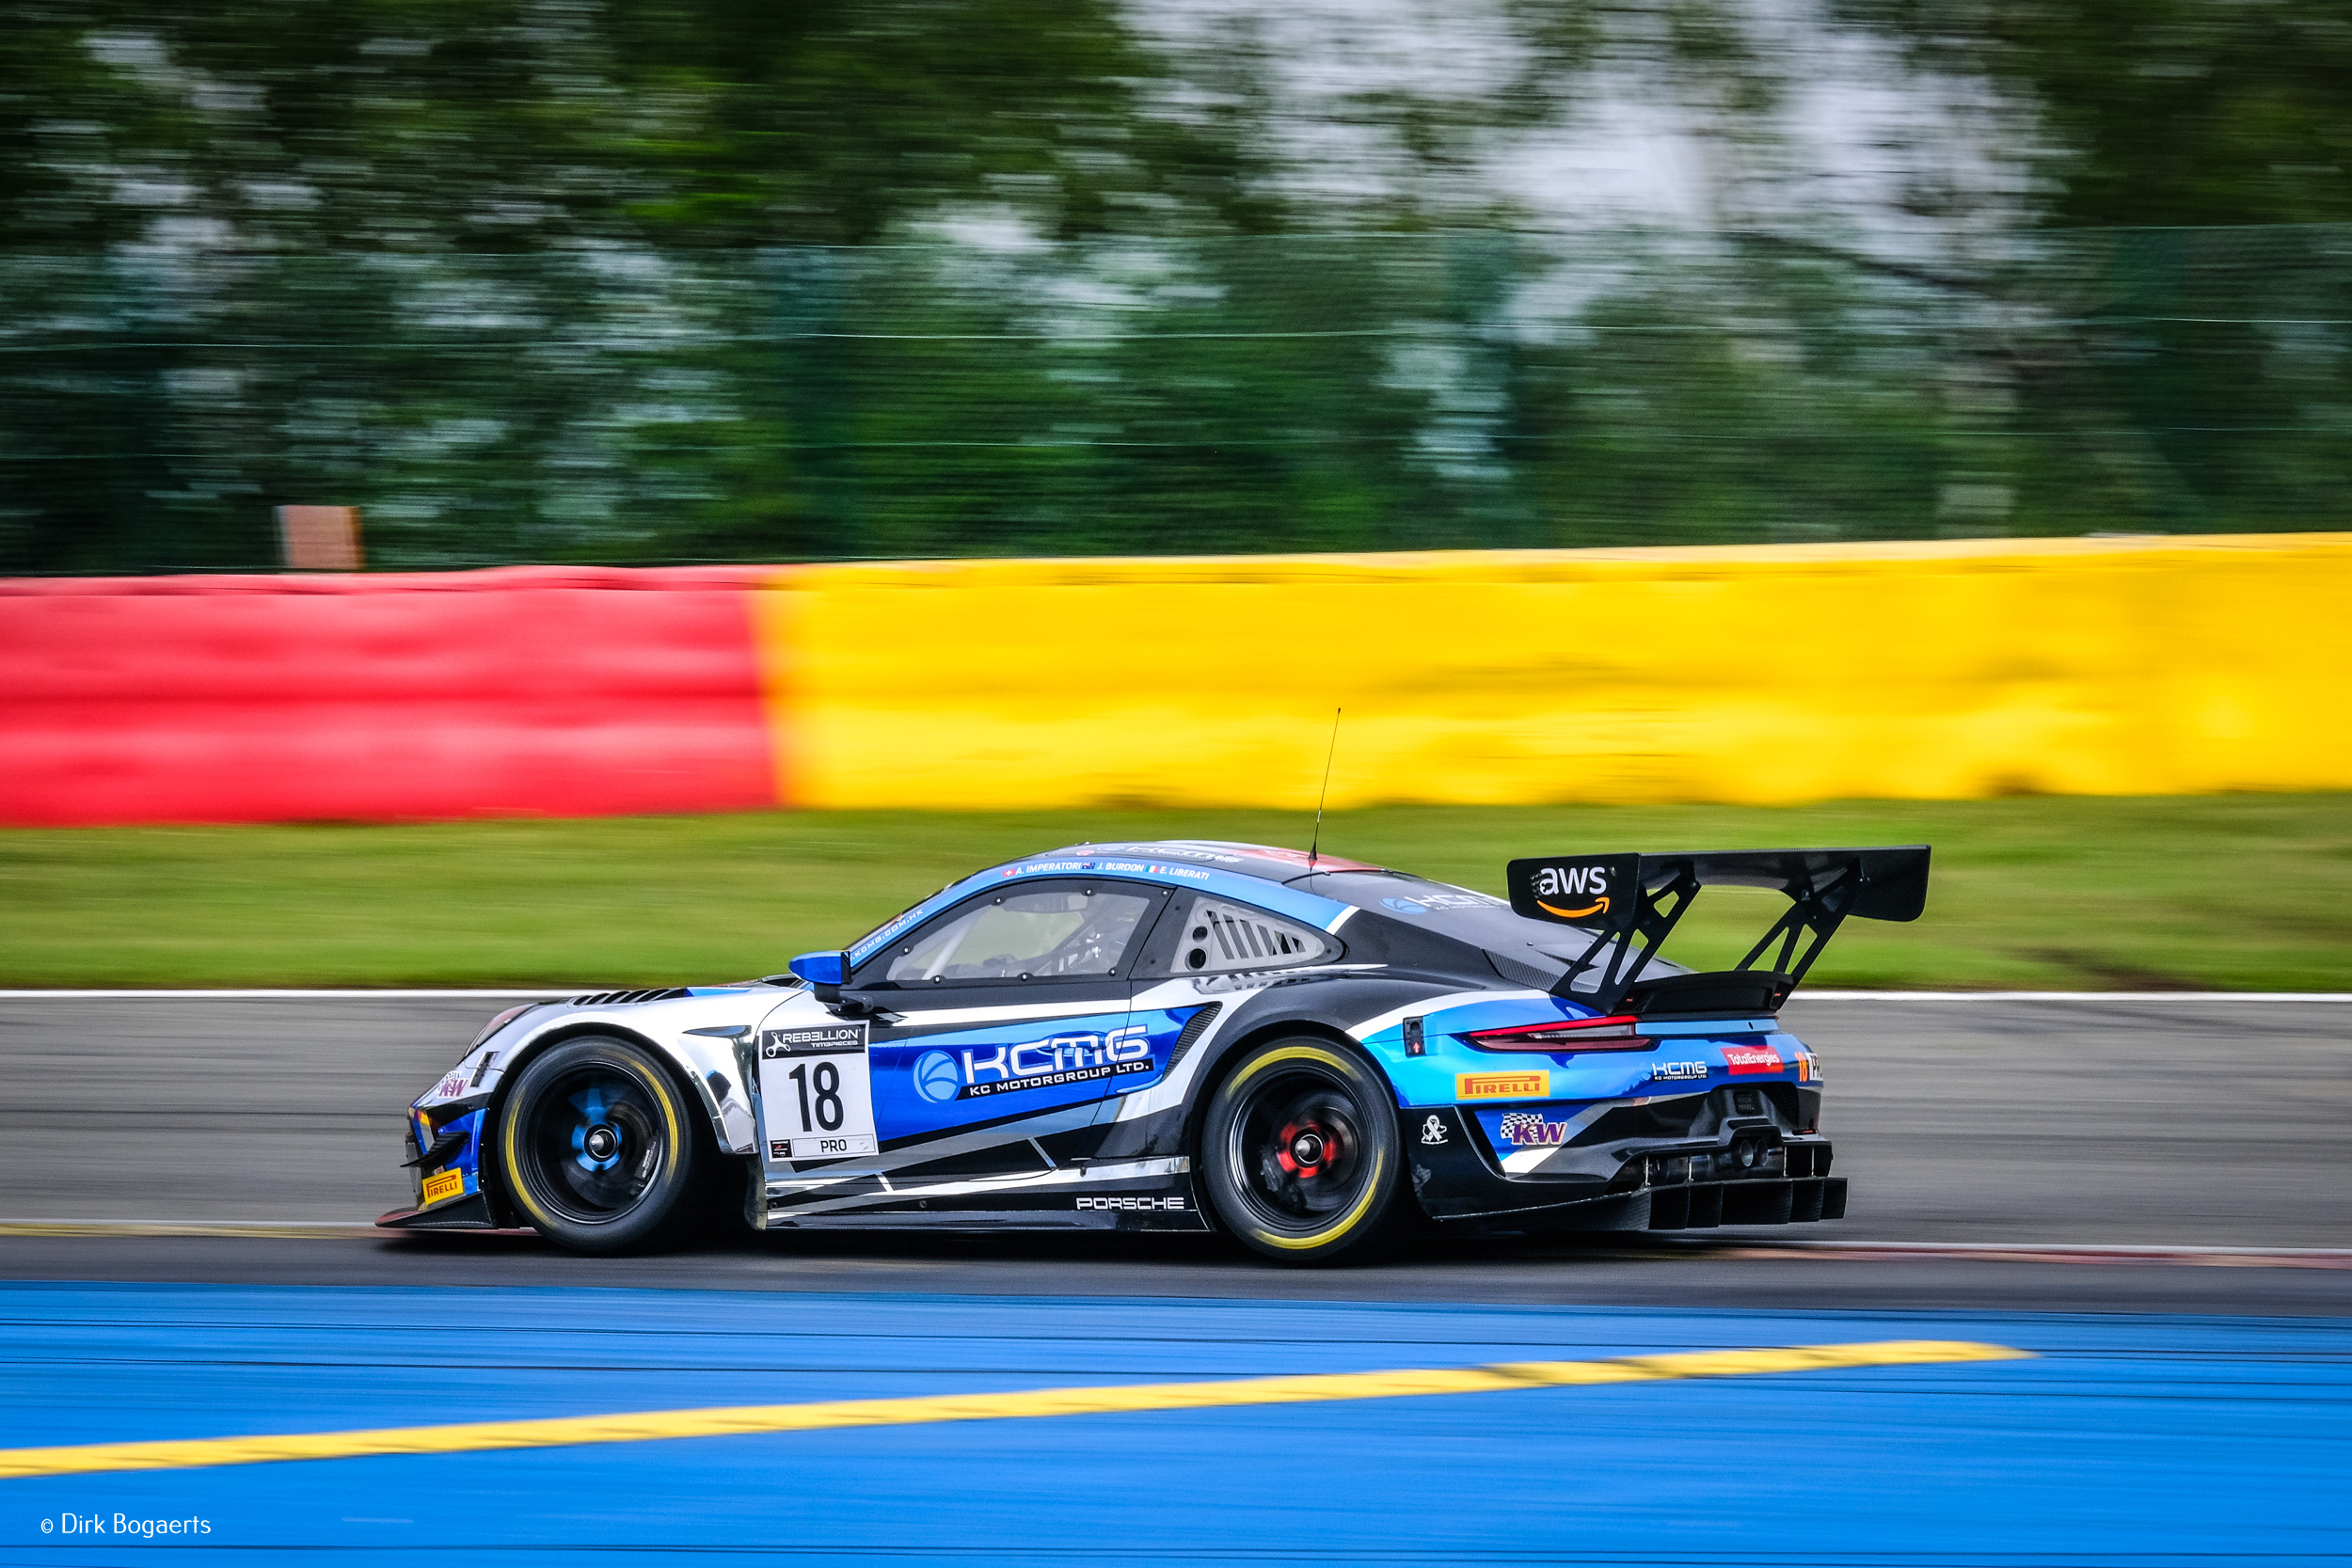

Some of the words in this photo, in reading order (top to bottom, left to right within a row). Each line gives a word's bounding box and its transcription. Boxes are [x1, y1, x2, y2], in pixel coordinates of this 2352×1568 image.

[1015, 867, 1025, 876] A.
[1025, 862, 1081, 874] IMPERATORI
[1096, 862, 1104, 871] J.
[1105, 863, 1144, 873] BURDON
[1159, 865, 1168, 875] E.
[1168, 867, 1210, 880] LIBERATI
[1539, 866, 1607, 895] aws
[962, 1023, 1149, 1085] KCMG
[1727, 1052, 1780, 1067] TotalEnergies
[970, 1085, 992, 1096] KC
[996, 1067, 1111, 1092] MOTORGROUP
[1116, 1061, 1150, 1074] LTD.
[1652, 1060, 1708, 1076] KCMG
[1464, 1075, 1541, 1095] PIRELLI
[788, 1061, 845, 1132] 18
[1511, 1121, 1568, 1146] KW
[820, 1139, 847, 1152] PRO
[426, 1174, 458, 1198] PIRELLI
[1075, 1196, 1184, 1211] PORSCHE
